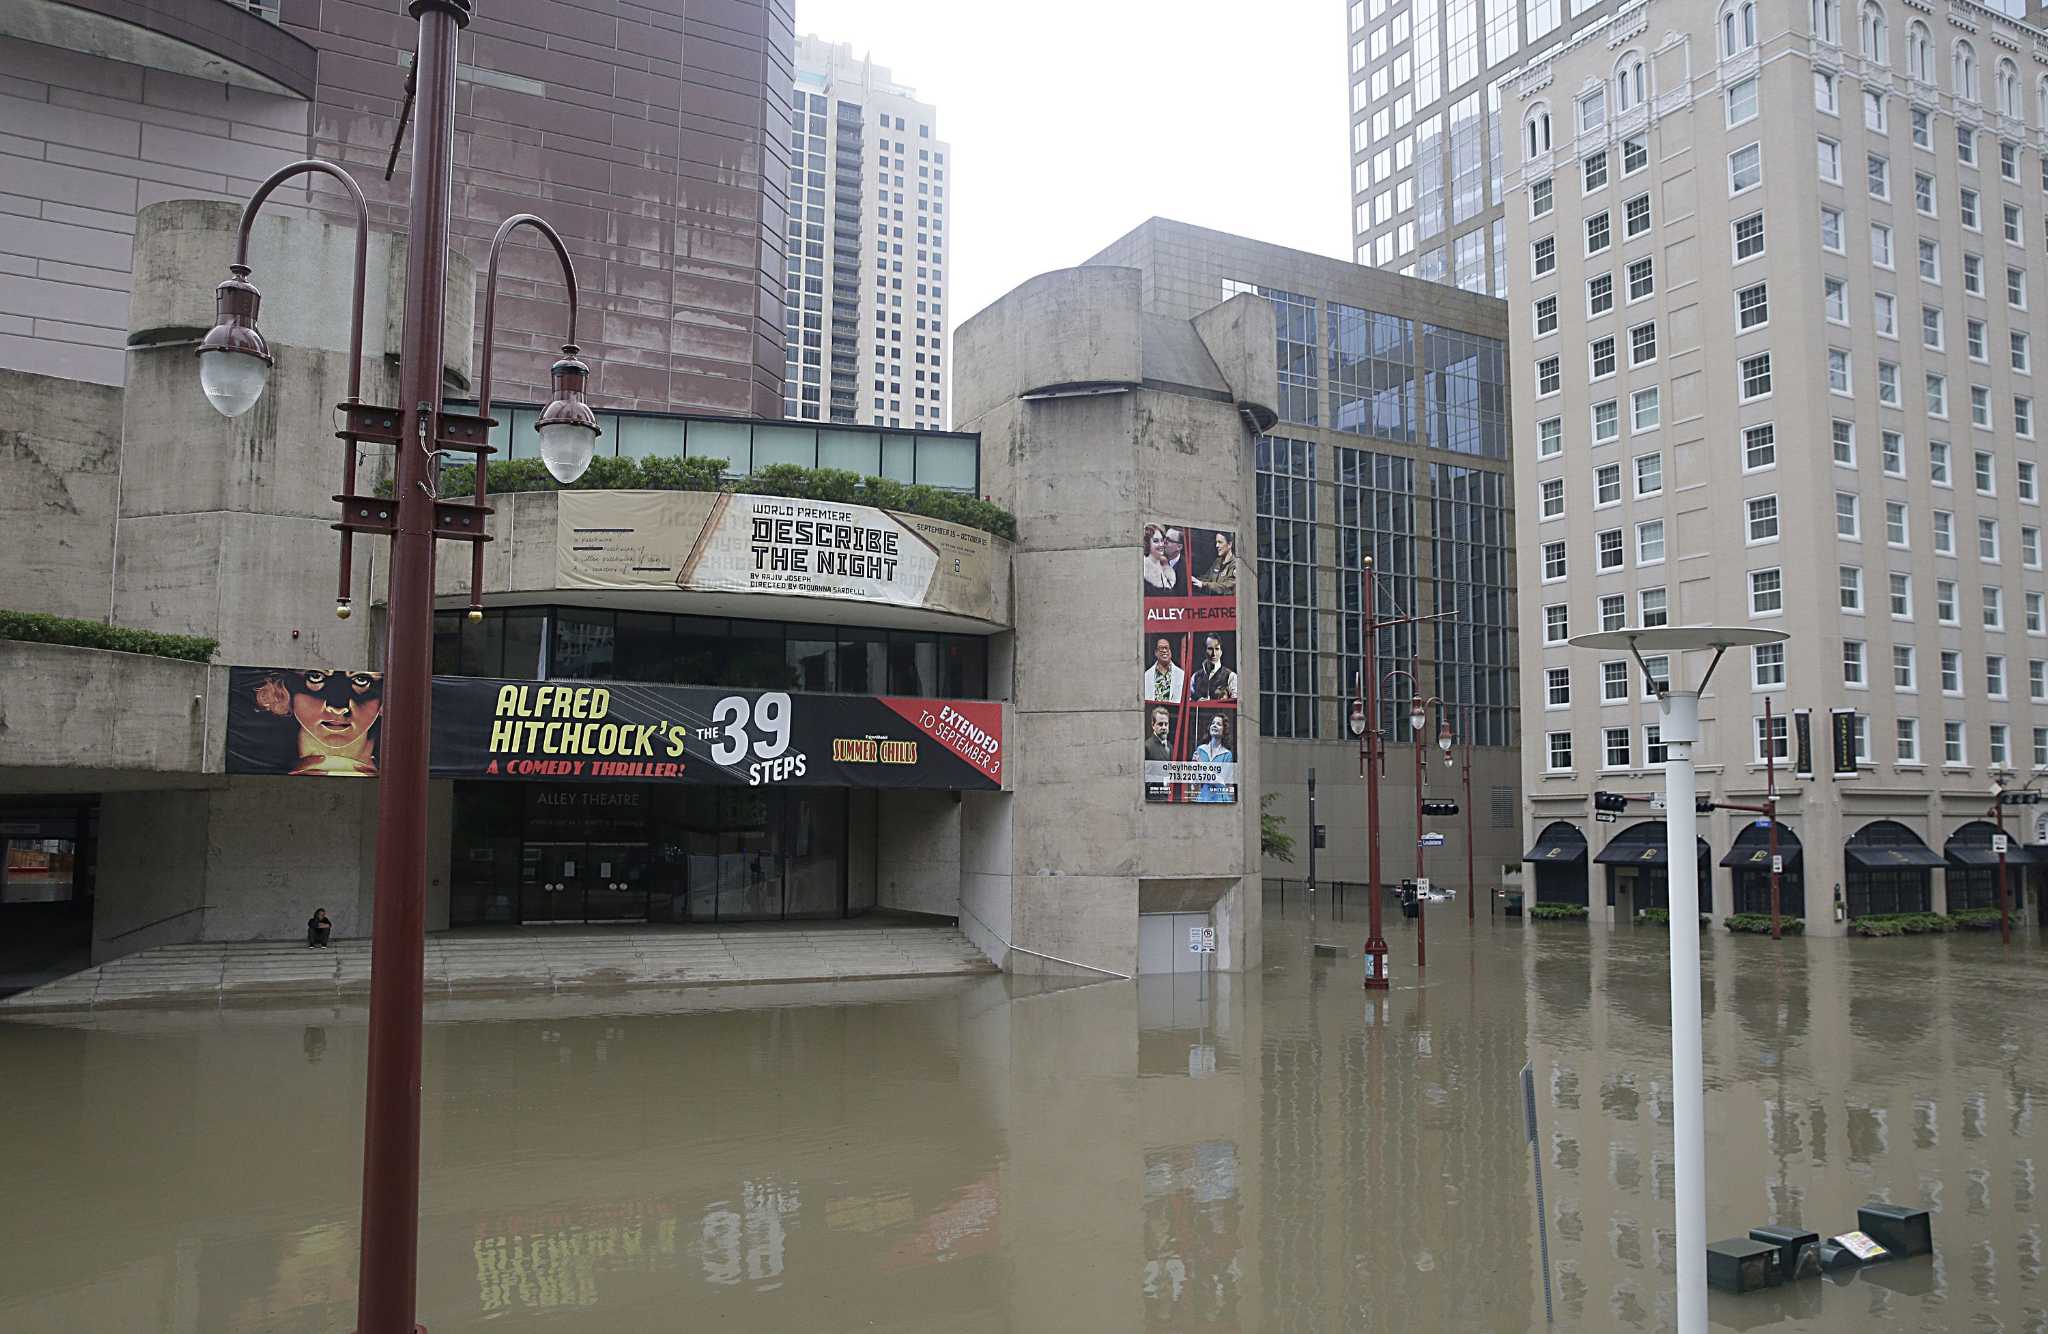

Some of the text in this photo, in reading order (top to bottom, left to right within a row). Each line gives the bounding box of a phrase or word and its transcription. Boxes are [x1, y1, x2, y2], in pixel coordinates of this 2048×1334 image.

[753, 504, 852, 522] WORLD PREMIERE
[752, 517, 899, 556] DESCRIBE
[752, 546, 808, 573] THE
[817, 550, 898, 581] NIGHT
[750, 572, 812, 583] BY RAJIV JOSEPH
[750, 580, 786, 590] DIRECTED
[495, 684, 610, 719] ALFRED
[489, 720, 686, 757] HITCHCOCK'S
[696, 727, 719, 740] THE
[711, 691, 792, 766] 39
[939, 705, 999, 754] EXTENDED
[833, 738, 918, 764] SUMMER CHILLS
[919, 710, 1000, 774] TO SEPTEMBER 3
[486, 759, 686, 777] A COMEDY THRILLER!
[749, 753, 806, 786] STEPS
[1162, 763, 1222, 773] alleytheatre.org
[1169, 772, 1217, 781] 713.220.5700
[536, 792, 640, 806] ALLEY THEATRE
